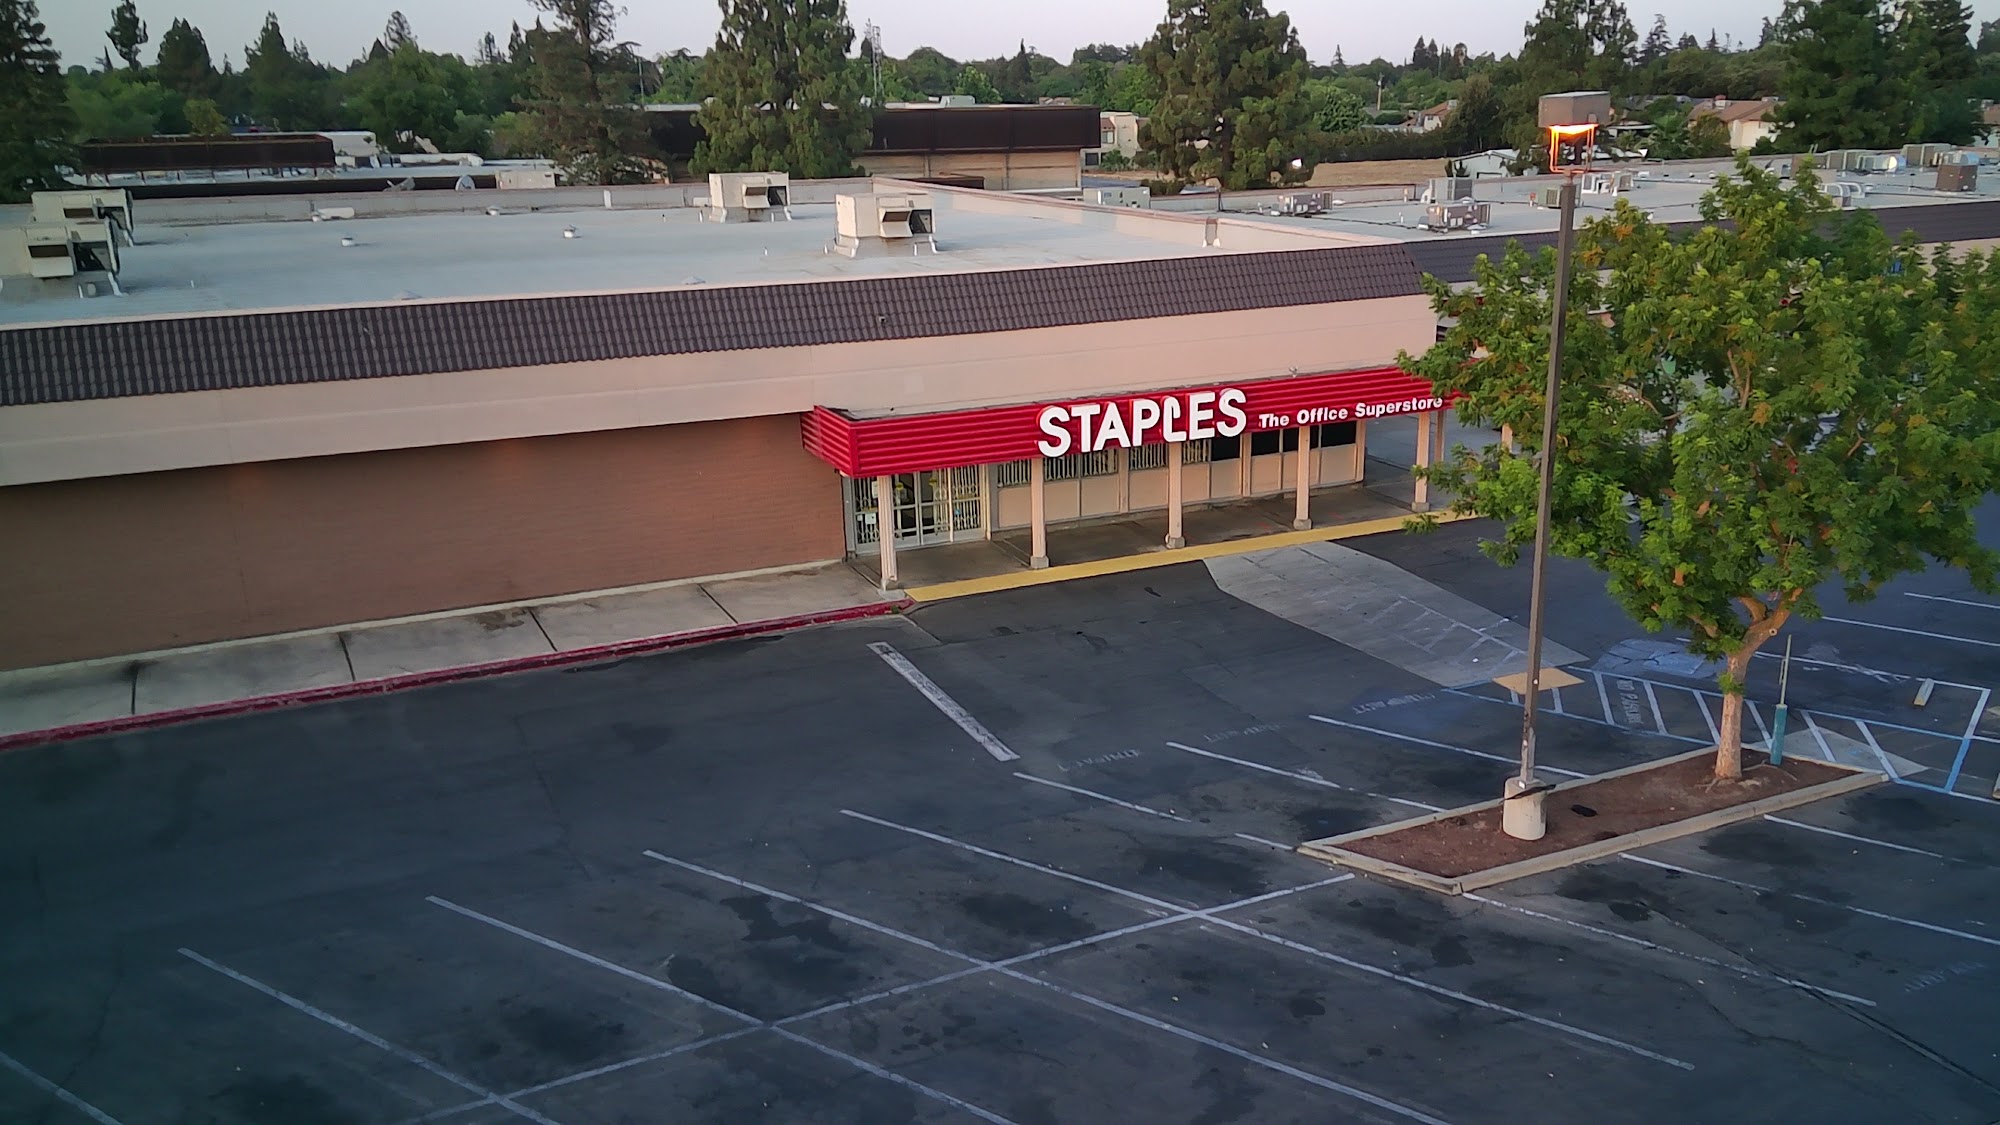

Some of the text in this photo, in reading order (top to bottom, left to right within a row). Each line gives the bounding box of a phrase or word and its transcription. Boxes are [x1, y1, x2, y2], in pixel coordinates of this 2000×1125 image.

[1036, 387, 1247, 458] STAPLES
[1259, 396, 1443, 428] The Office Superstore
